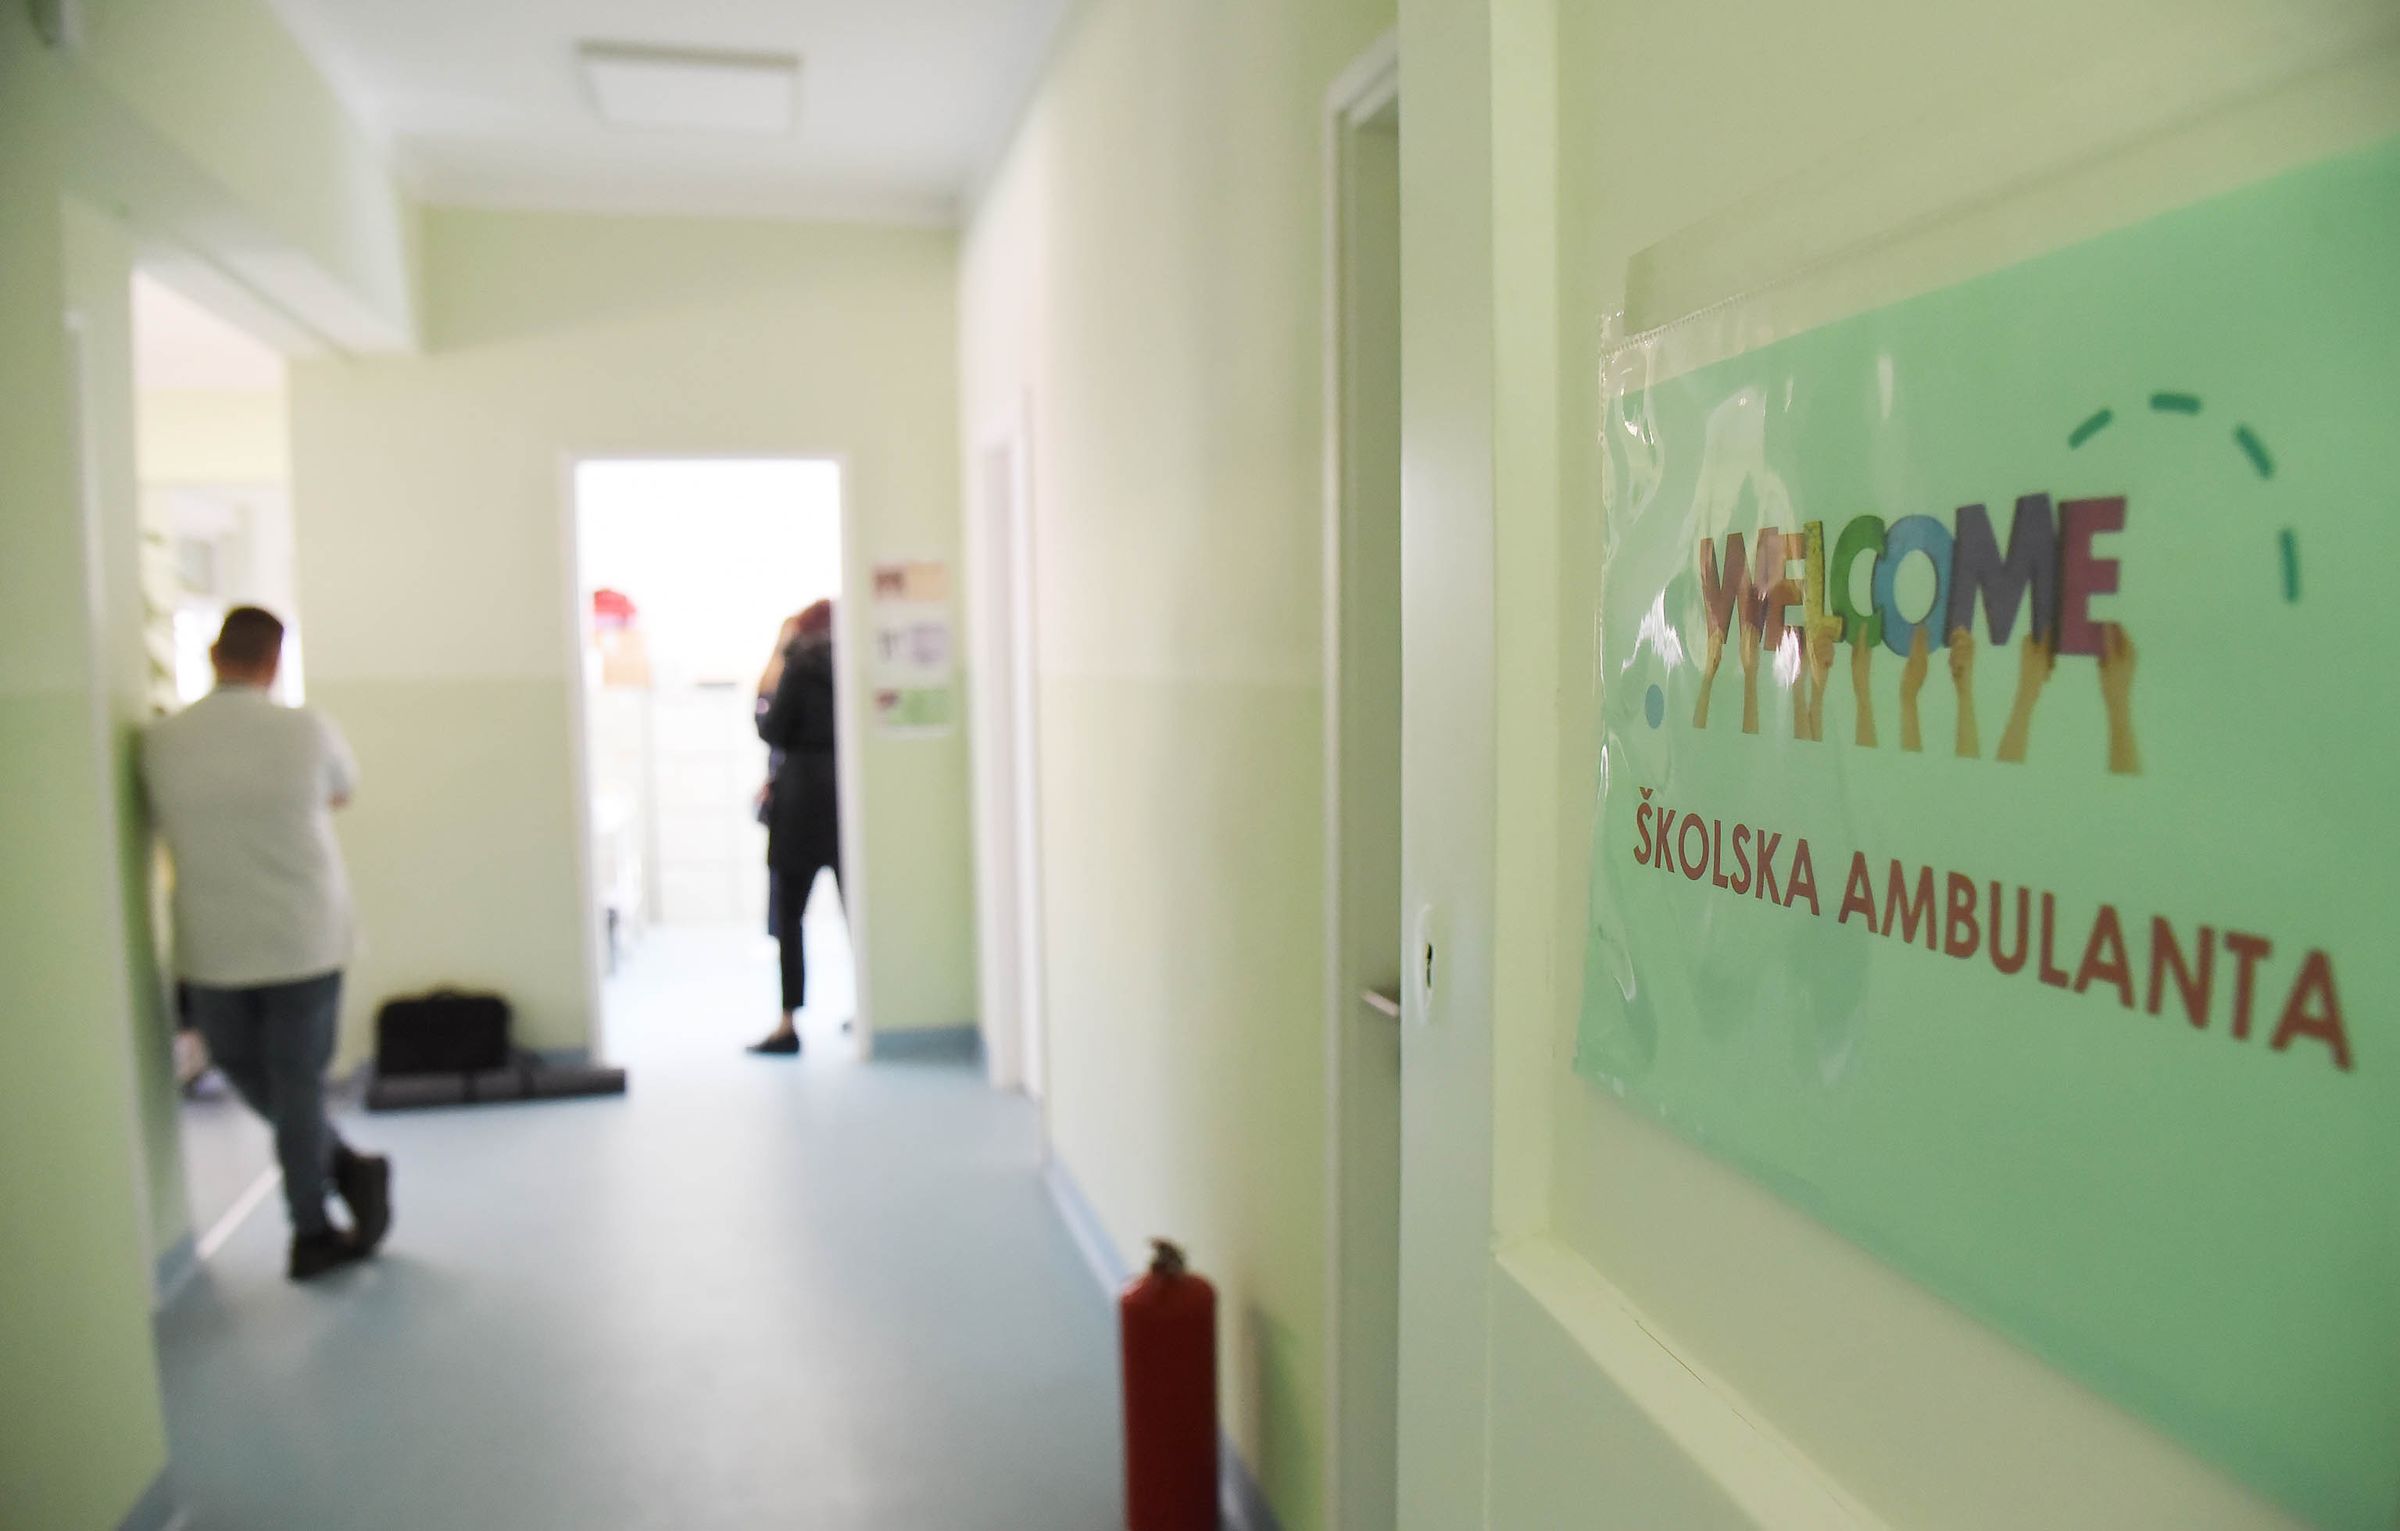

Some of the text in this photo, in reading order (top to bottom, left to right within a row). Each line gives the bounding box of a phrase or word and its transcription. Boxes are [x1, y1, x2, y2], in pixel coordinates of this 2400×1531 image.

[1700, 493, 2127, 657] WELCOME
[1634, 787, 2354, 1072] ŠKOLSKA AMBULANTA
